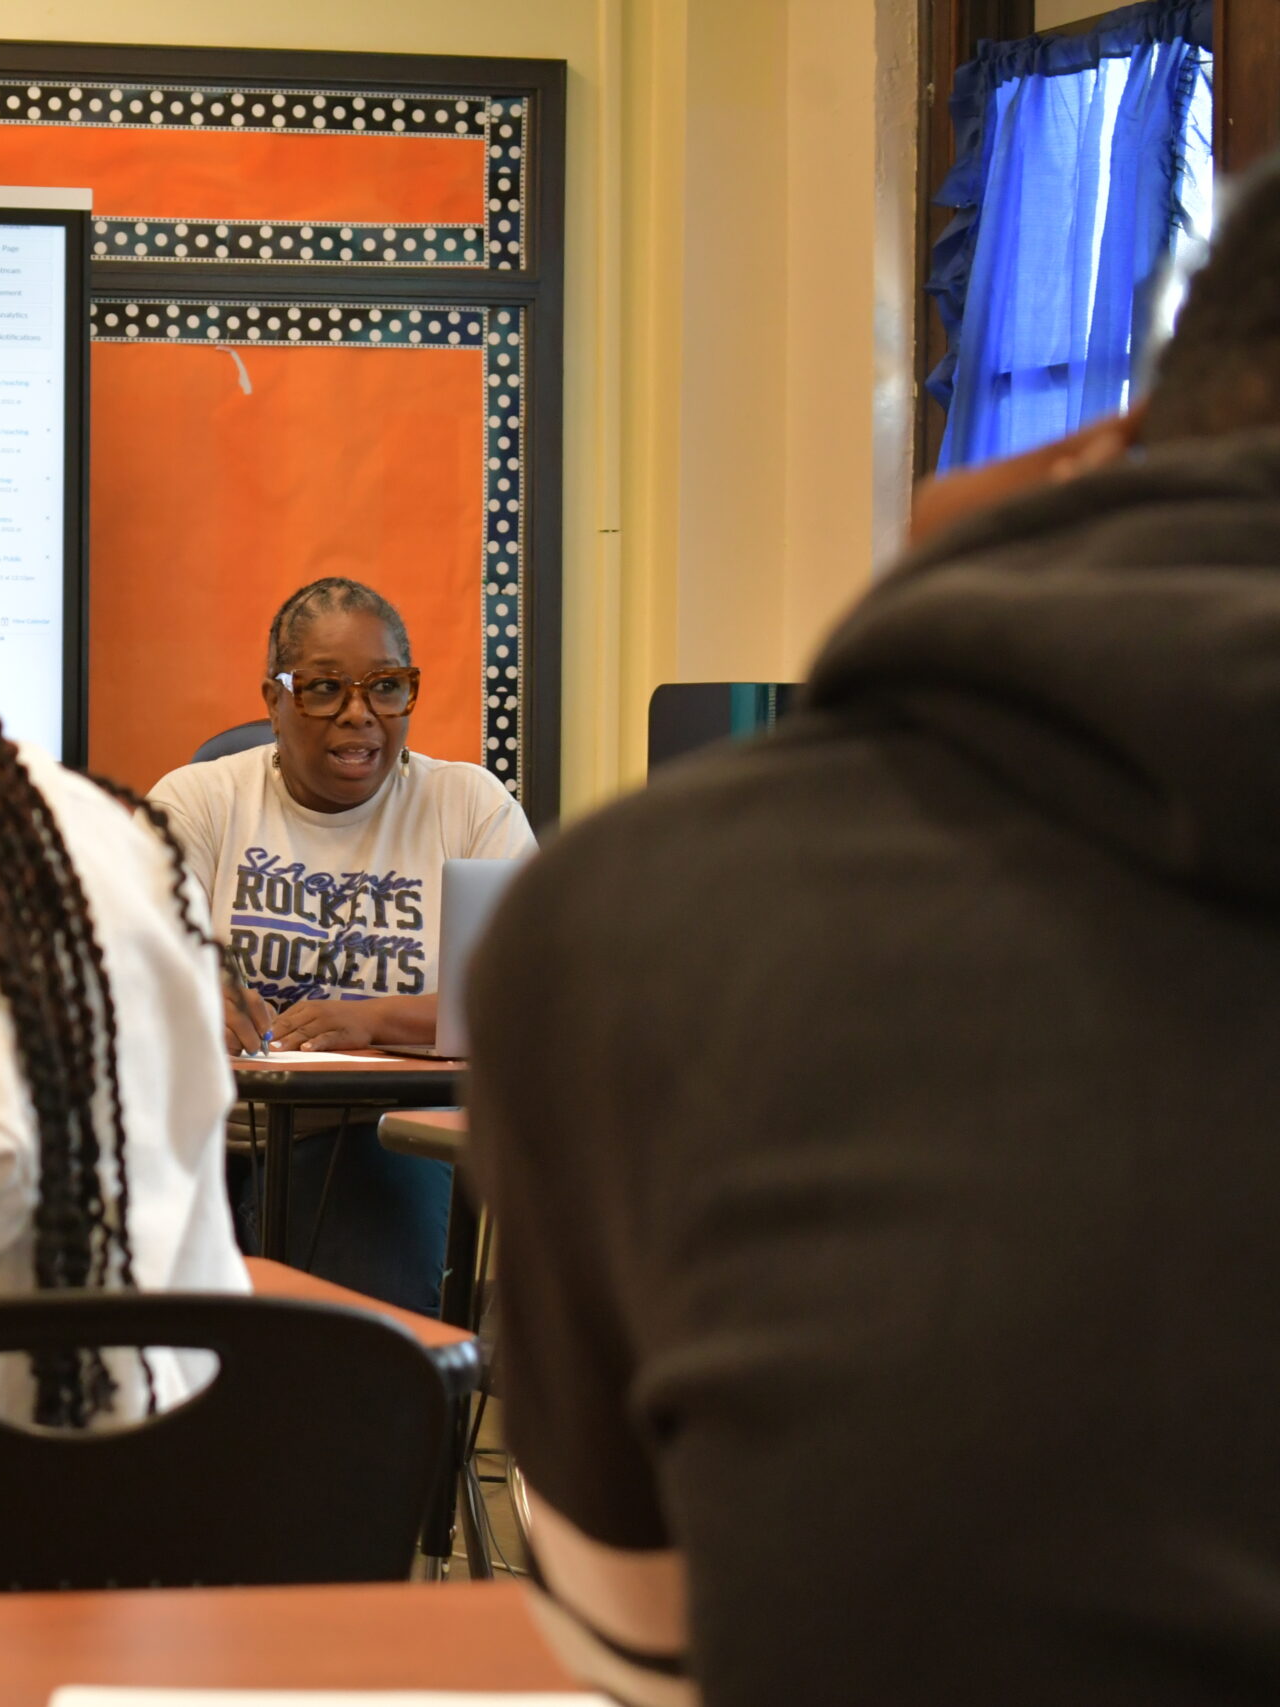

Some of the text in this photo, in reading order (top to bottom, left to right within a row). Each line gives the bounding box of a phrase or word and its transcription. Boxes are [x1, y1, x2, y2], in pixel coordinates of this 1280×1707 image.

[2, 244, 19, 253] Page
[244, 847, 306, 882] SLA
[232, 865, 424, 931] ROCKETS
[230, 928, 425, 994] ROCKETS
[246, 979, 331, 1002] reate
